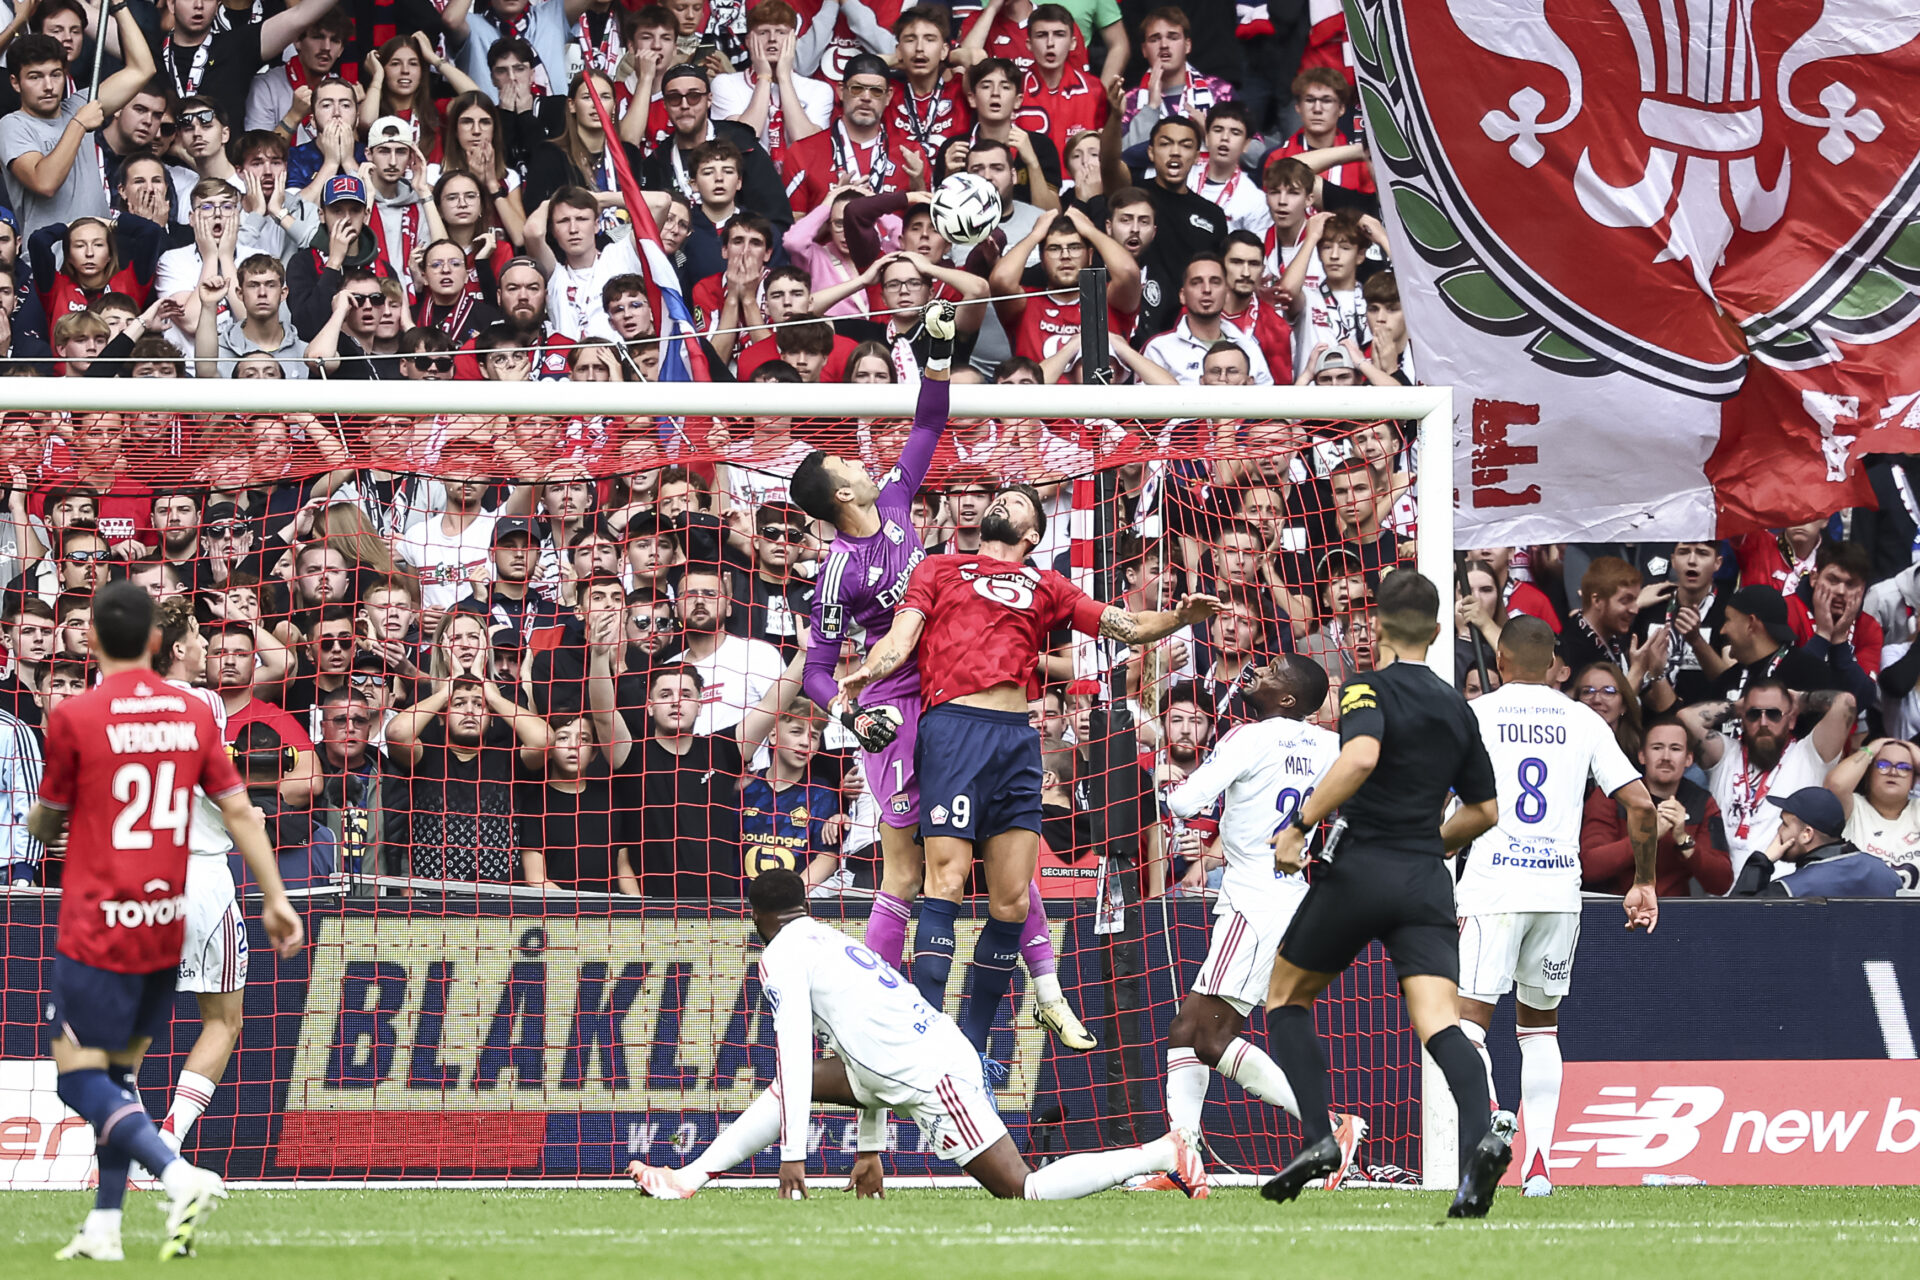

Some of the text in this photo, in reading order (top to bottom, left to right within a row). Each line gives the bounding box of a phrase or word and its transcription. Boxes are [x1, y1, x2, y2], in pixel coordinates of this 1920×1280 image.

[1498, 705, 1566, 716] AUSHPPING
[1497, 723, 1567, 745] TOLISSO
[892, 759, 903, 792] 1
[1515, 757, 1548, 824] 8
[112, 760, 189, 850] 24
[951, 795, 971, 828] 9
[1081, 867, 1098, 877] PRIV
[1492, 853, 1575, 869] Brazzaville
[100, 895, 187, 928] TOYOT
[1722, 1109, 1870, 1154] new
